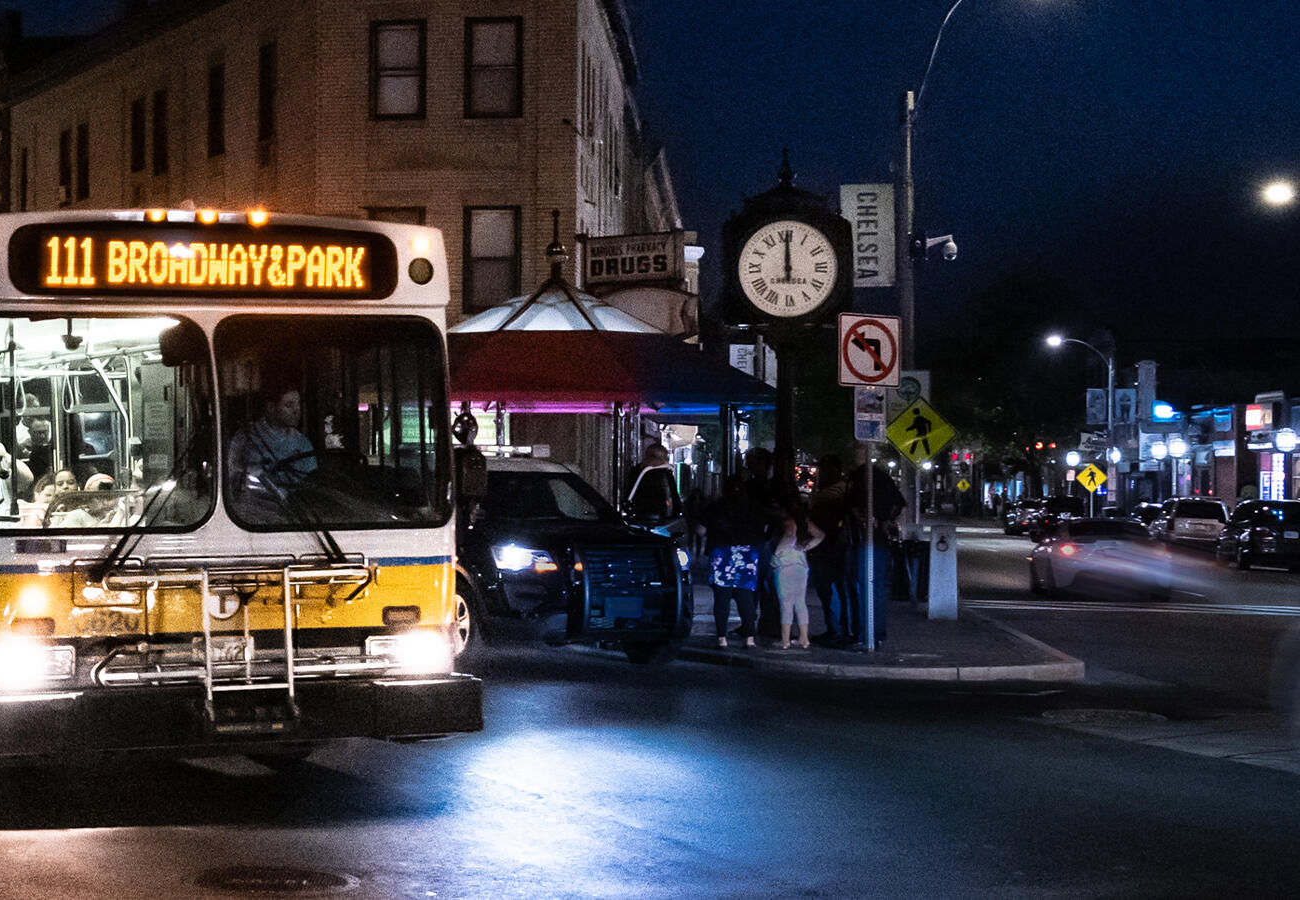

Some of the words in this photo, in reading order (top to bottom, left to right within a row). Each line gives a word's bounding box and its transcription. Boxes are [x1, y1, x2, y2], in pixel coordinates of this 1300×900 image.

[857, 192, 878, 279] CHELSEA
[626, 241, 666, 254] PHARMACY
[47, 236, 95, 285] 111
[108, 241, 365, 288] BROADWAY&PARK
[591, 255, 667, 276] DRUGS
[815, 262, 828, 273] III
